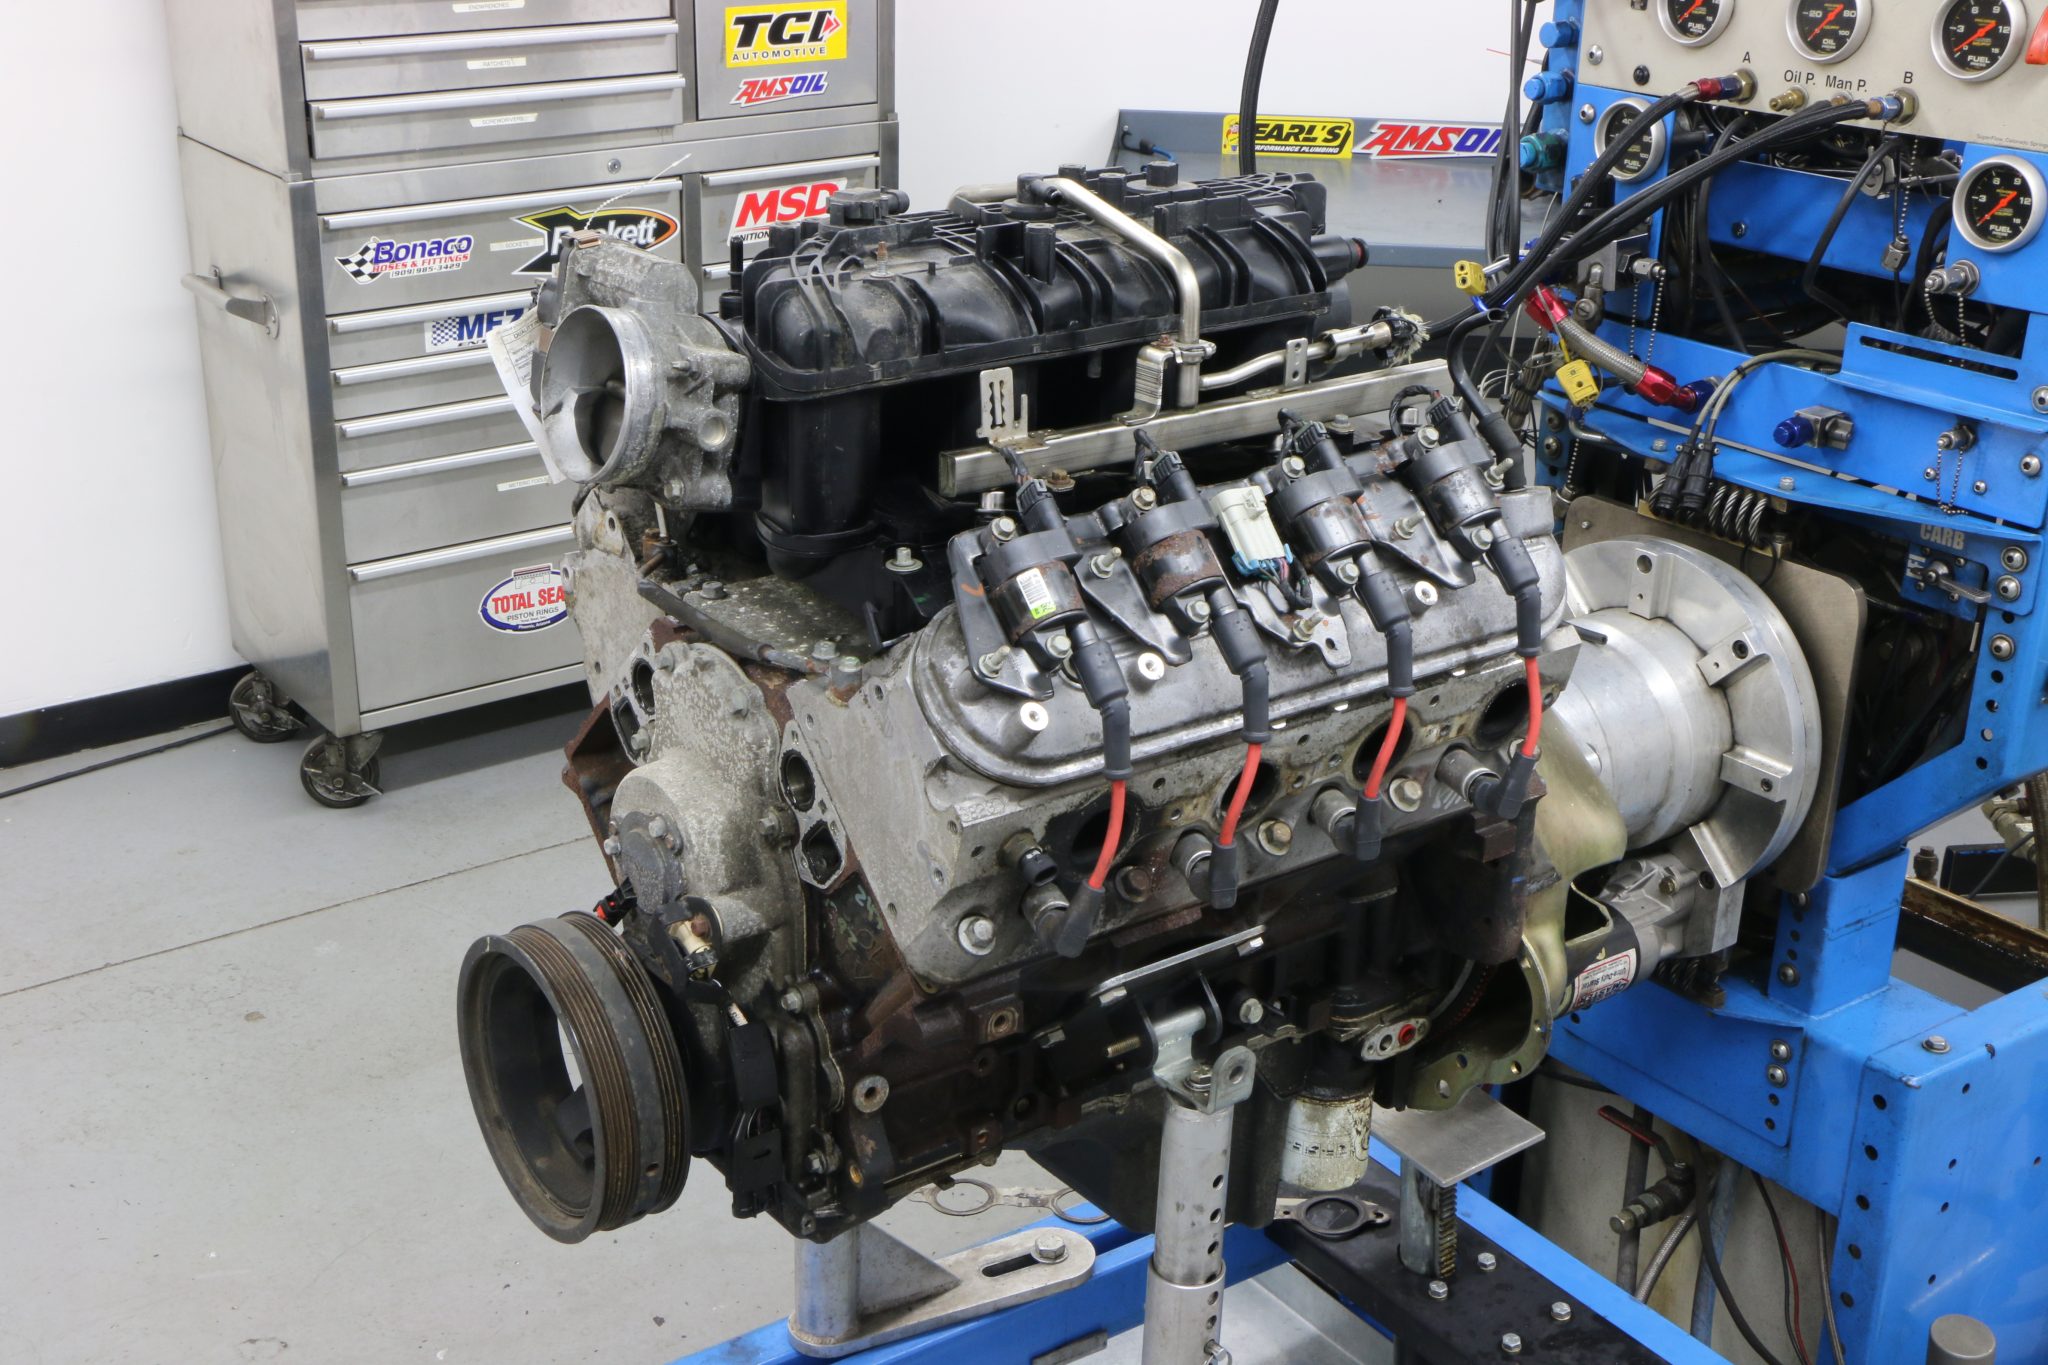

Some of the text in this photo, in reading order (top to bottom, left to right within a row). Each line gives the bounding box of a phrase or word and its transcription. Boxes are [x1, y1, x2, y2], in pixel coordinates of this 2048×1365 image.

[1809, 10, 1822, 18] 20
[1843, 10, 1857, 18] 80
[1992, 6, 2001, 14] 9
[733, 10, 833, 49] TCI
[1688, 22, 1706, 31] FUEL
[1956, 25, 1965, 33] 3
[1998, 26, 2010, 34] 12
[1822, 38, 1836, 46] OIL
[732, 46, 826, 61] AUTOMOTIVE
[1742, 51, 1751, 64] A
[1967, 55, 1990, 63] FUEL
[1783, 69, 1817, 86] Oil P.
[1903, 71, 1914, 84] B
[735, 74, 825, 104] AMSOIL
[1825, 74, 1868, 93] Man P.
[1254, 123, 1345, 143] EARL'S
[1362, 123, 1503, 156] AMSOI
[1255, 144, 1339, 154] RFORMANCE PLUMBING
[1624, 159, 1641, 167] FUEL
[2013, 178, 2022, 186] 9
[1978, 195, 1987, 203] 3
[2019, 197, 2032, 205] 12
[735, 182, 839, 228] MSD
[1989, 224, 2013, 233] FUEL
[740, 231, 769, 241] NITION
[374, 236, 472, 264] Bonaco
[372, 253, 469, 273] HOSES & FITTINGS
[1920, 523, 1965, 550] CARB
[492, 585, 565, 614] TOTAL SEA
[507, 607, 559, 621] PISTON RINGS
